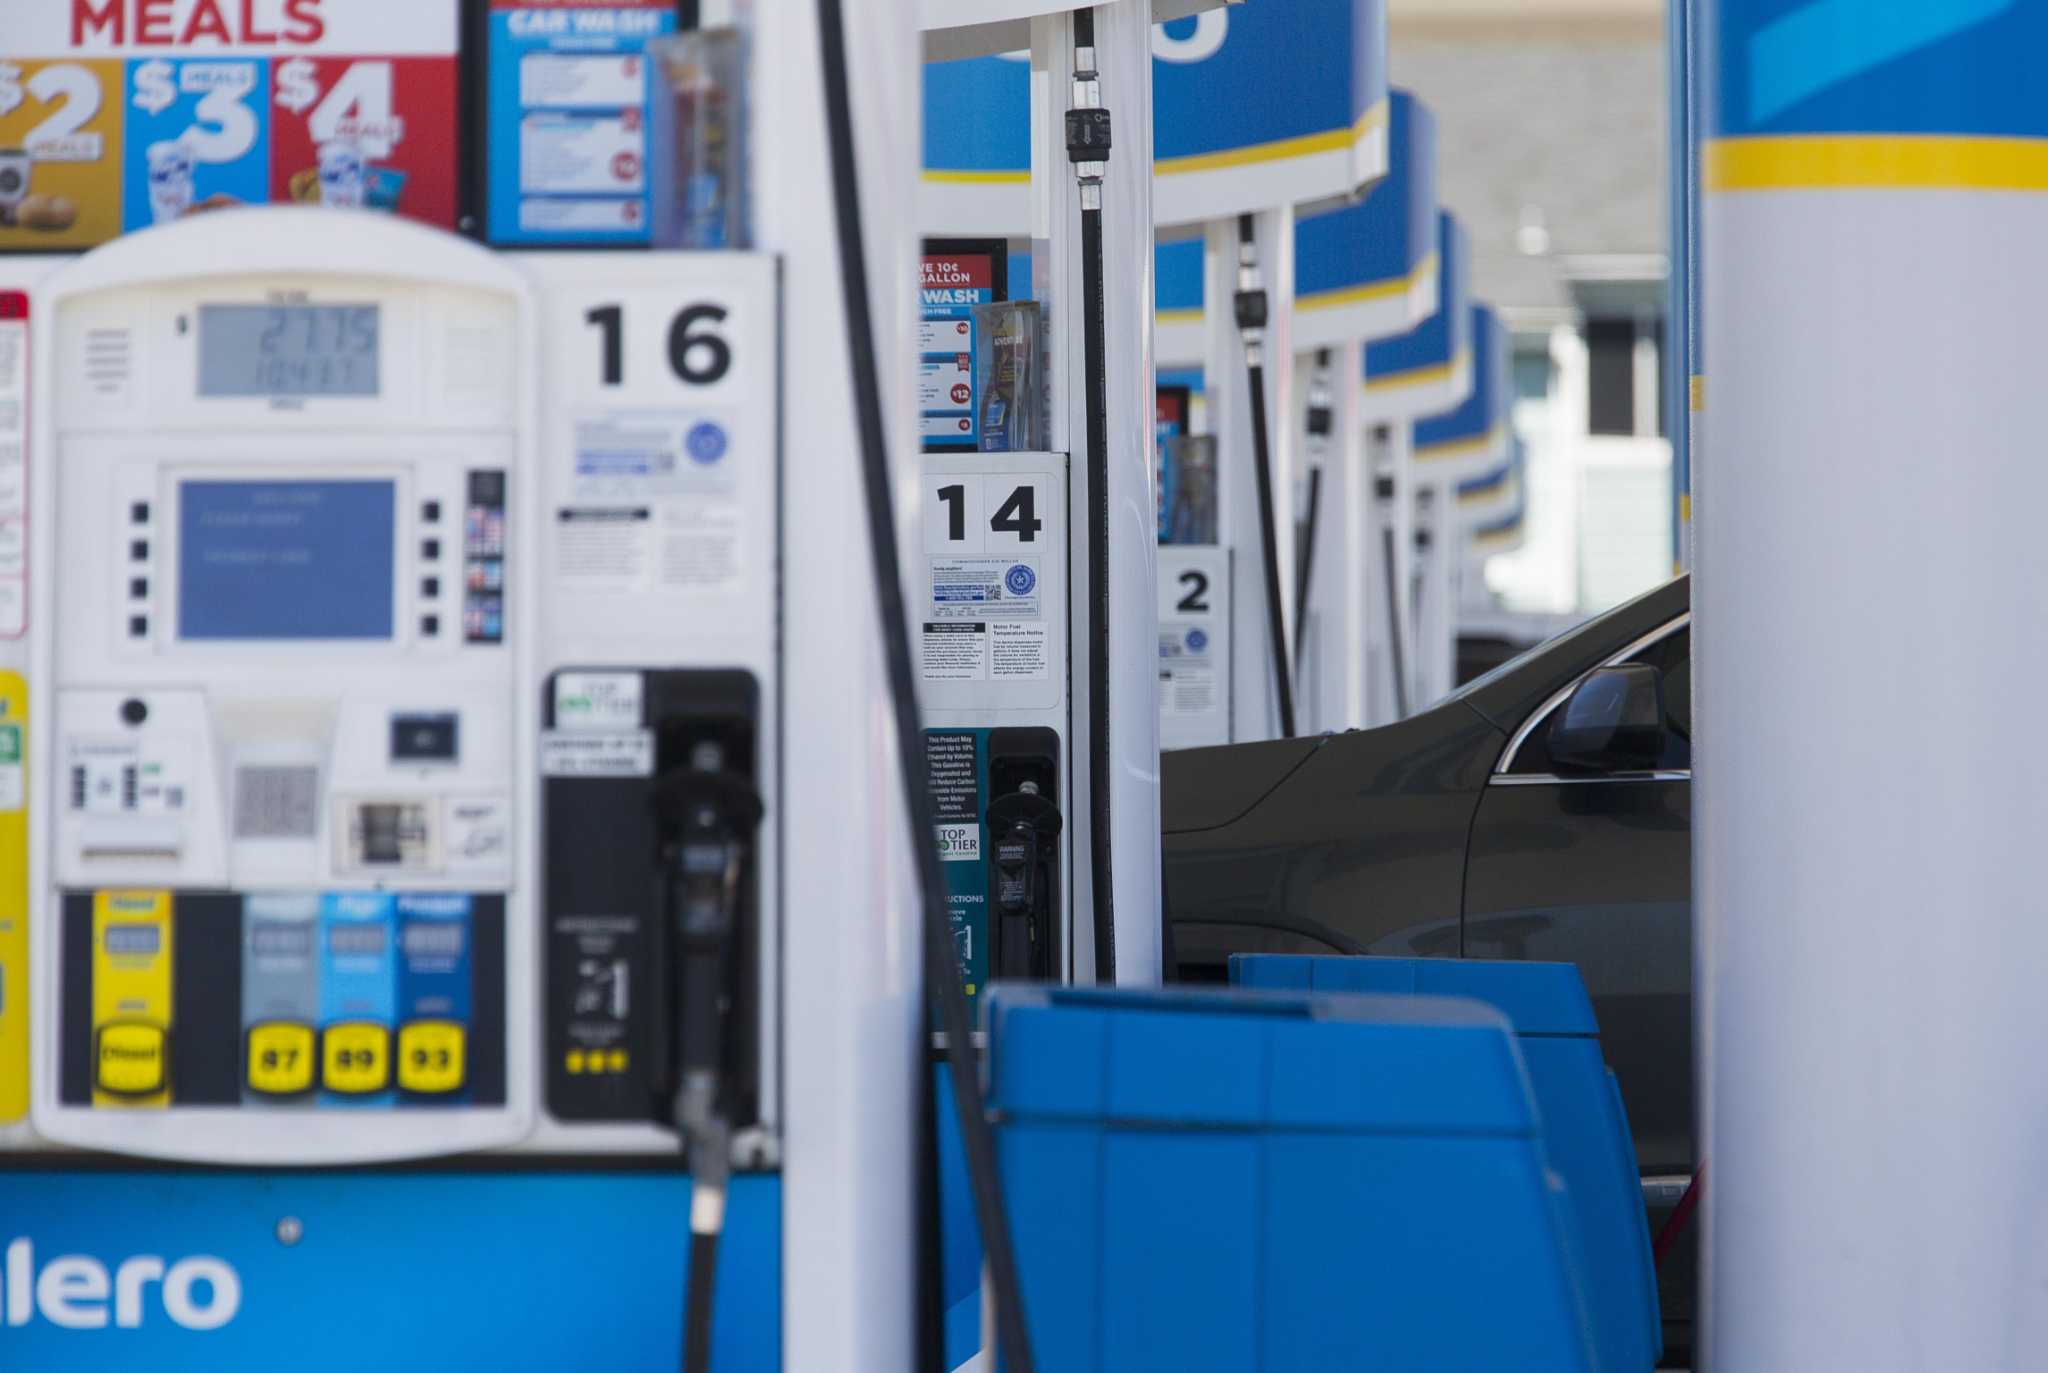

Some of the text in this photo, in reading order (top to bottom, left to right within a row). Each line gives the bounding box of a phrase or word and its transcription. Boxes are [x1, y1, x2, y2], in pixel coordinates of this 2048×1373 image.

[70, 0, 325, 46] MEALS
[923, 289, 980, 304] WASH
[937, 484, 1042, 543] 14
[941, 829, 966, 840] TOP
[951, 840, 977, 850] TIER
[945, 895, 984, 903] UCTIONS
[0, 1236, 242, 1331] lero
